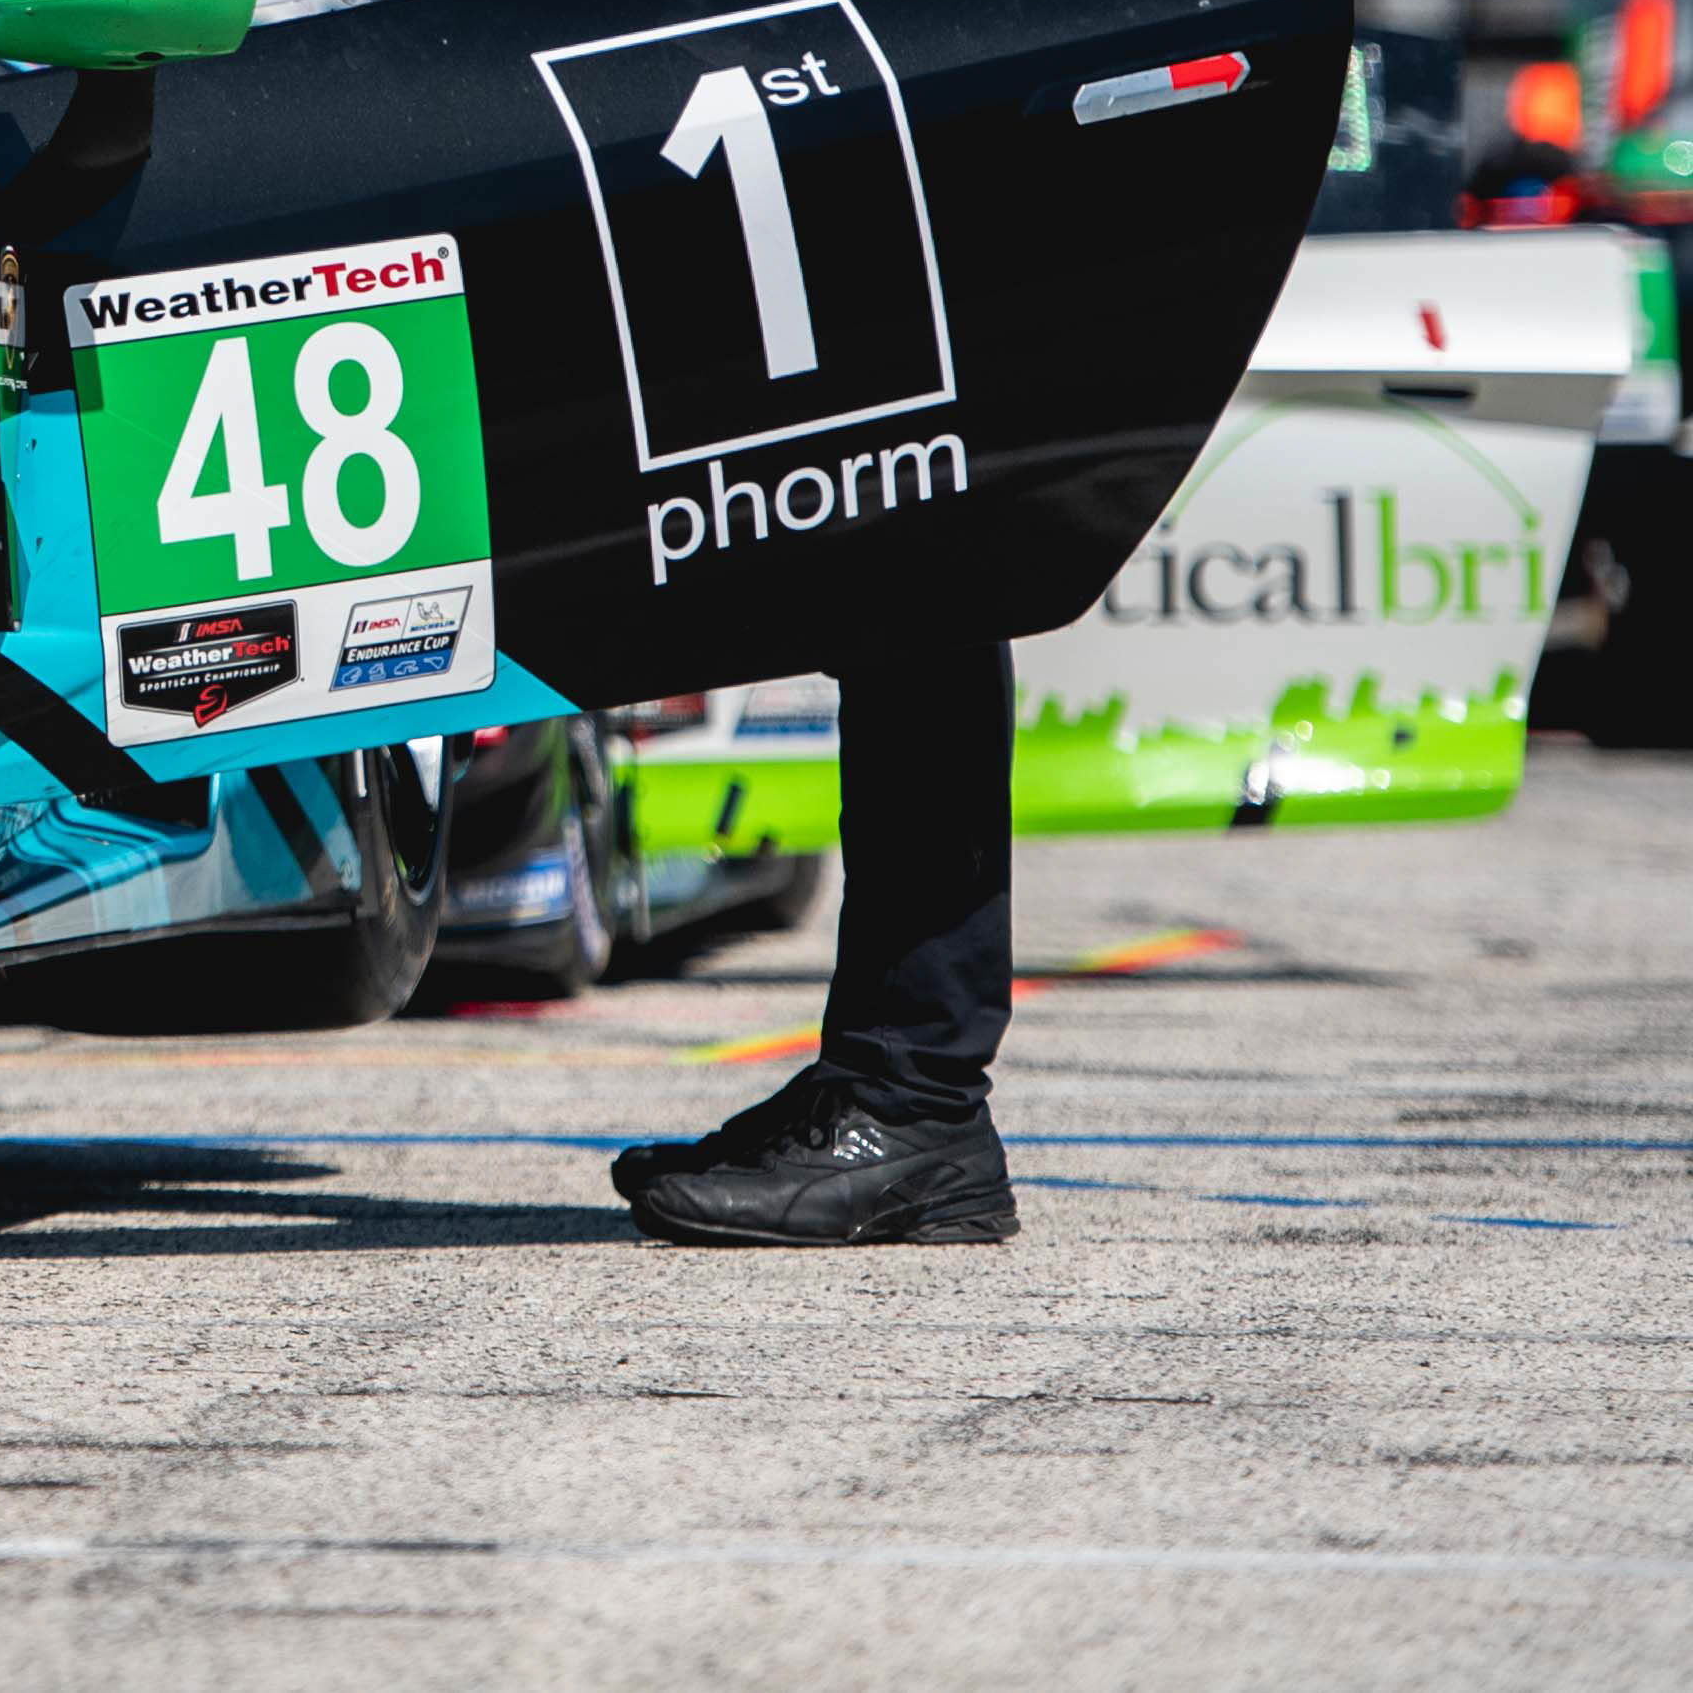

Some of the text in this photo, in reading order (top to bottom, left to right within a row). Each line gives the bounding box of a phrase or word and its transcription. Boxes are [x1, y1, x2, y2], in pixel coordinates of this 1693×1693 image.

[157, 321, 421, 581] 48
[648, 433, 968, 585] phorm
[195, 618, 243, 638] IMSA
